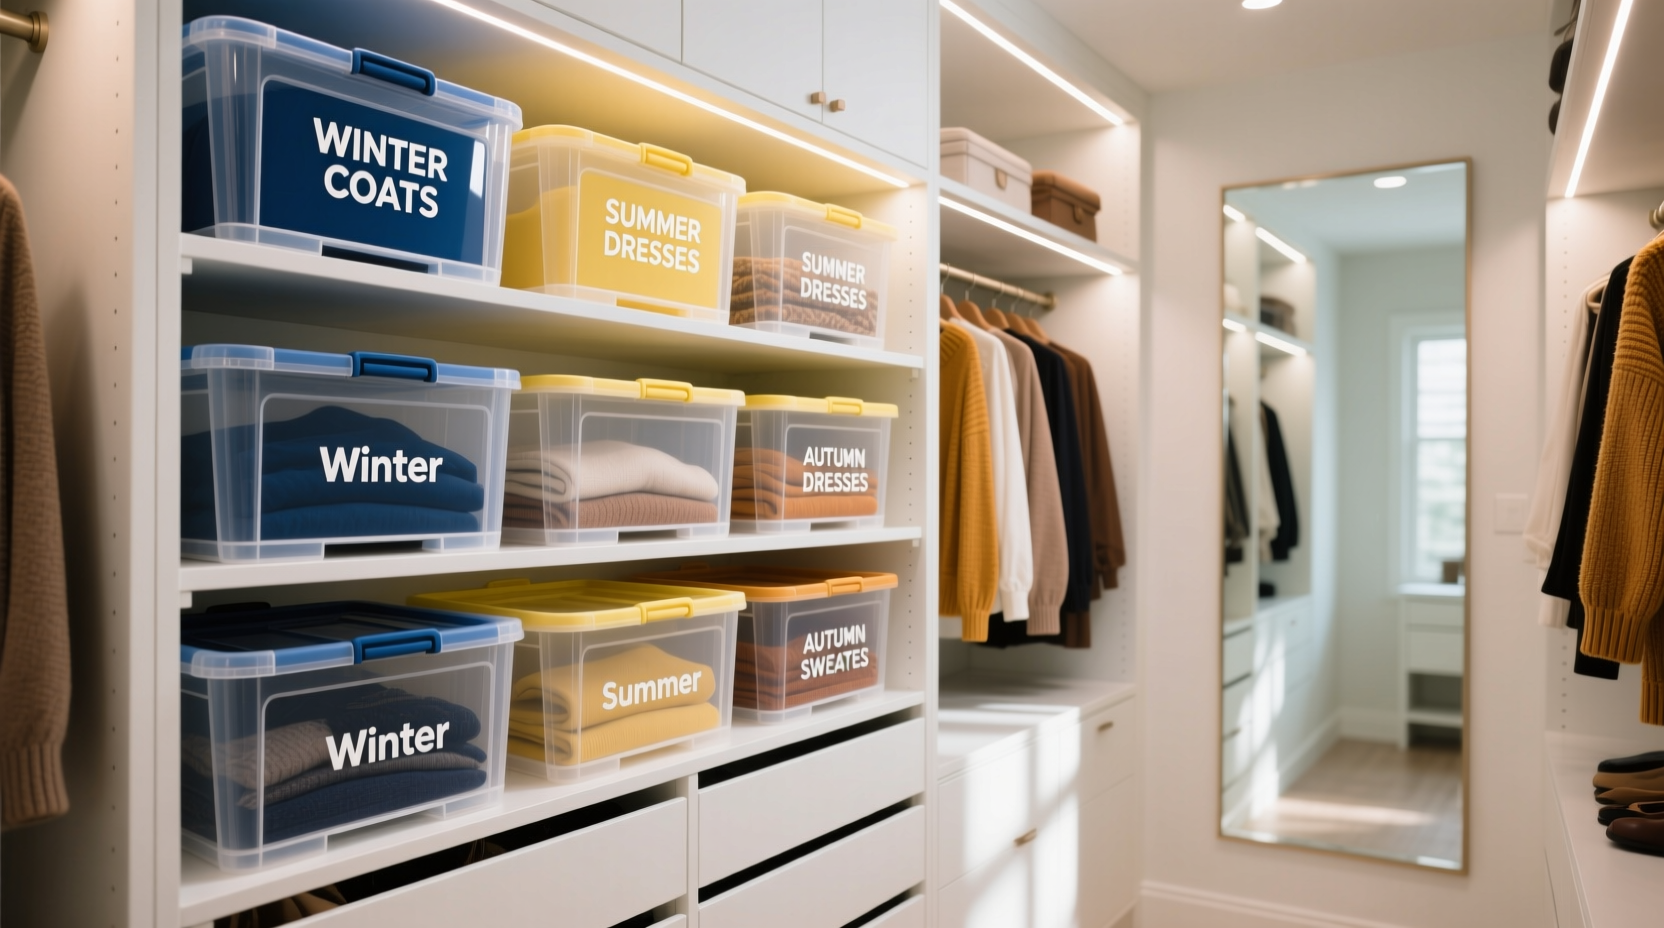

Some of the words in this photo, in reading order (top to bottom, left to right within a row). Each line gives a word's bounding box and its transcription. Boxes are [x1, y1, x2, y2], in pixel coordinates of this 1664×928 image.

[313, 117, 448, 182] WINTER
[324, 164, 438, 219] COATS
[604, 198, 701, 244] SUMMER
[604, 230, 700, 274] DRESSES
[800, 276, 867, 311] DRESSES
[319, 445, 443, 483] Winter
[803, 446, 866, 468] AUTUMN
[802, 471, 869, 493] DRESSES
[803, 623, 866, 655] AUTUMN
[800, 647, 869, 680] SWEATES
[602, 670, 702, 710] Summer
[325, 721, 450, 771] Winter
